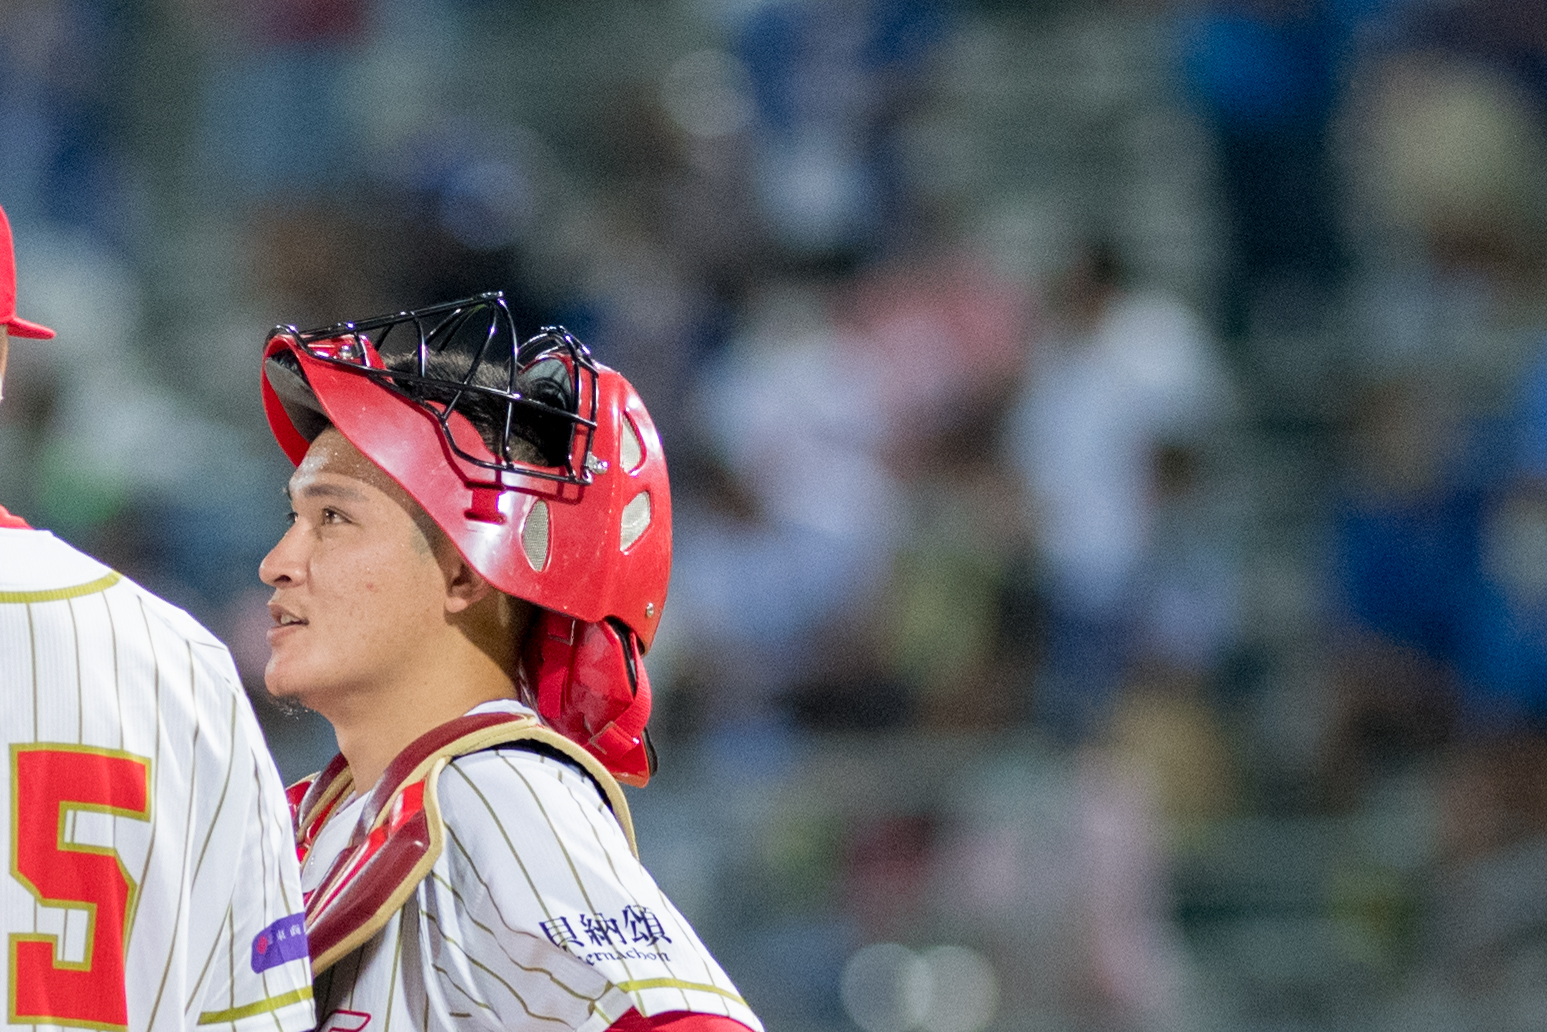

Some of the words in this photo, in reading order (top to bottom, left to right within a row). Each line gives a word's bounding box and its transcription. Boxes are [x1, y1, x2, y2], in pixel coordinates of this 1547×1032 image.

[539, 904, 672, 952] 貝納頌
[575, 948, 671, 967] ernachon
